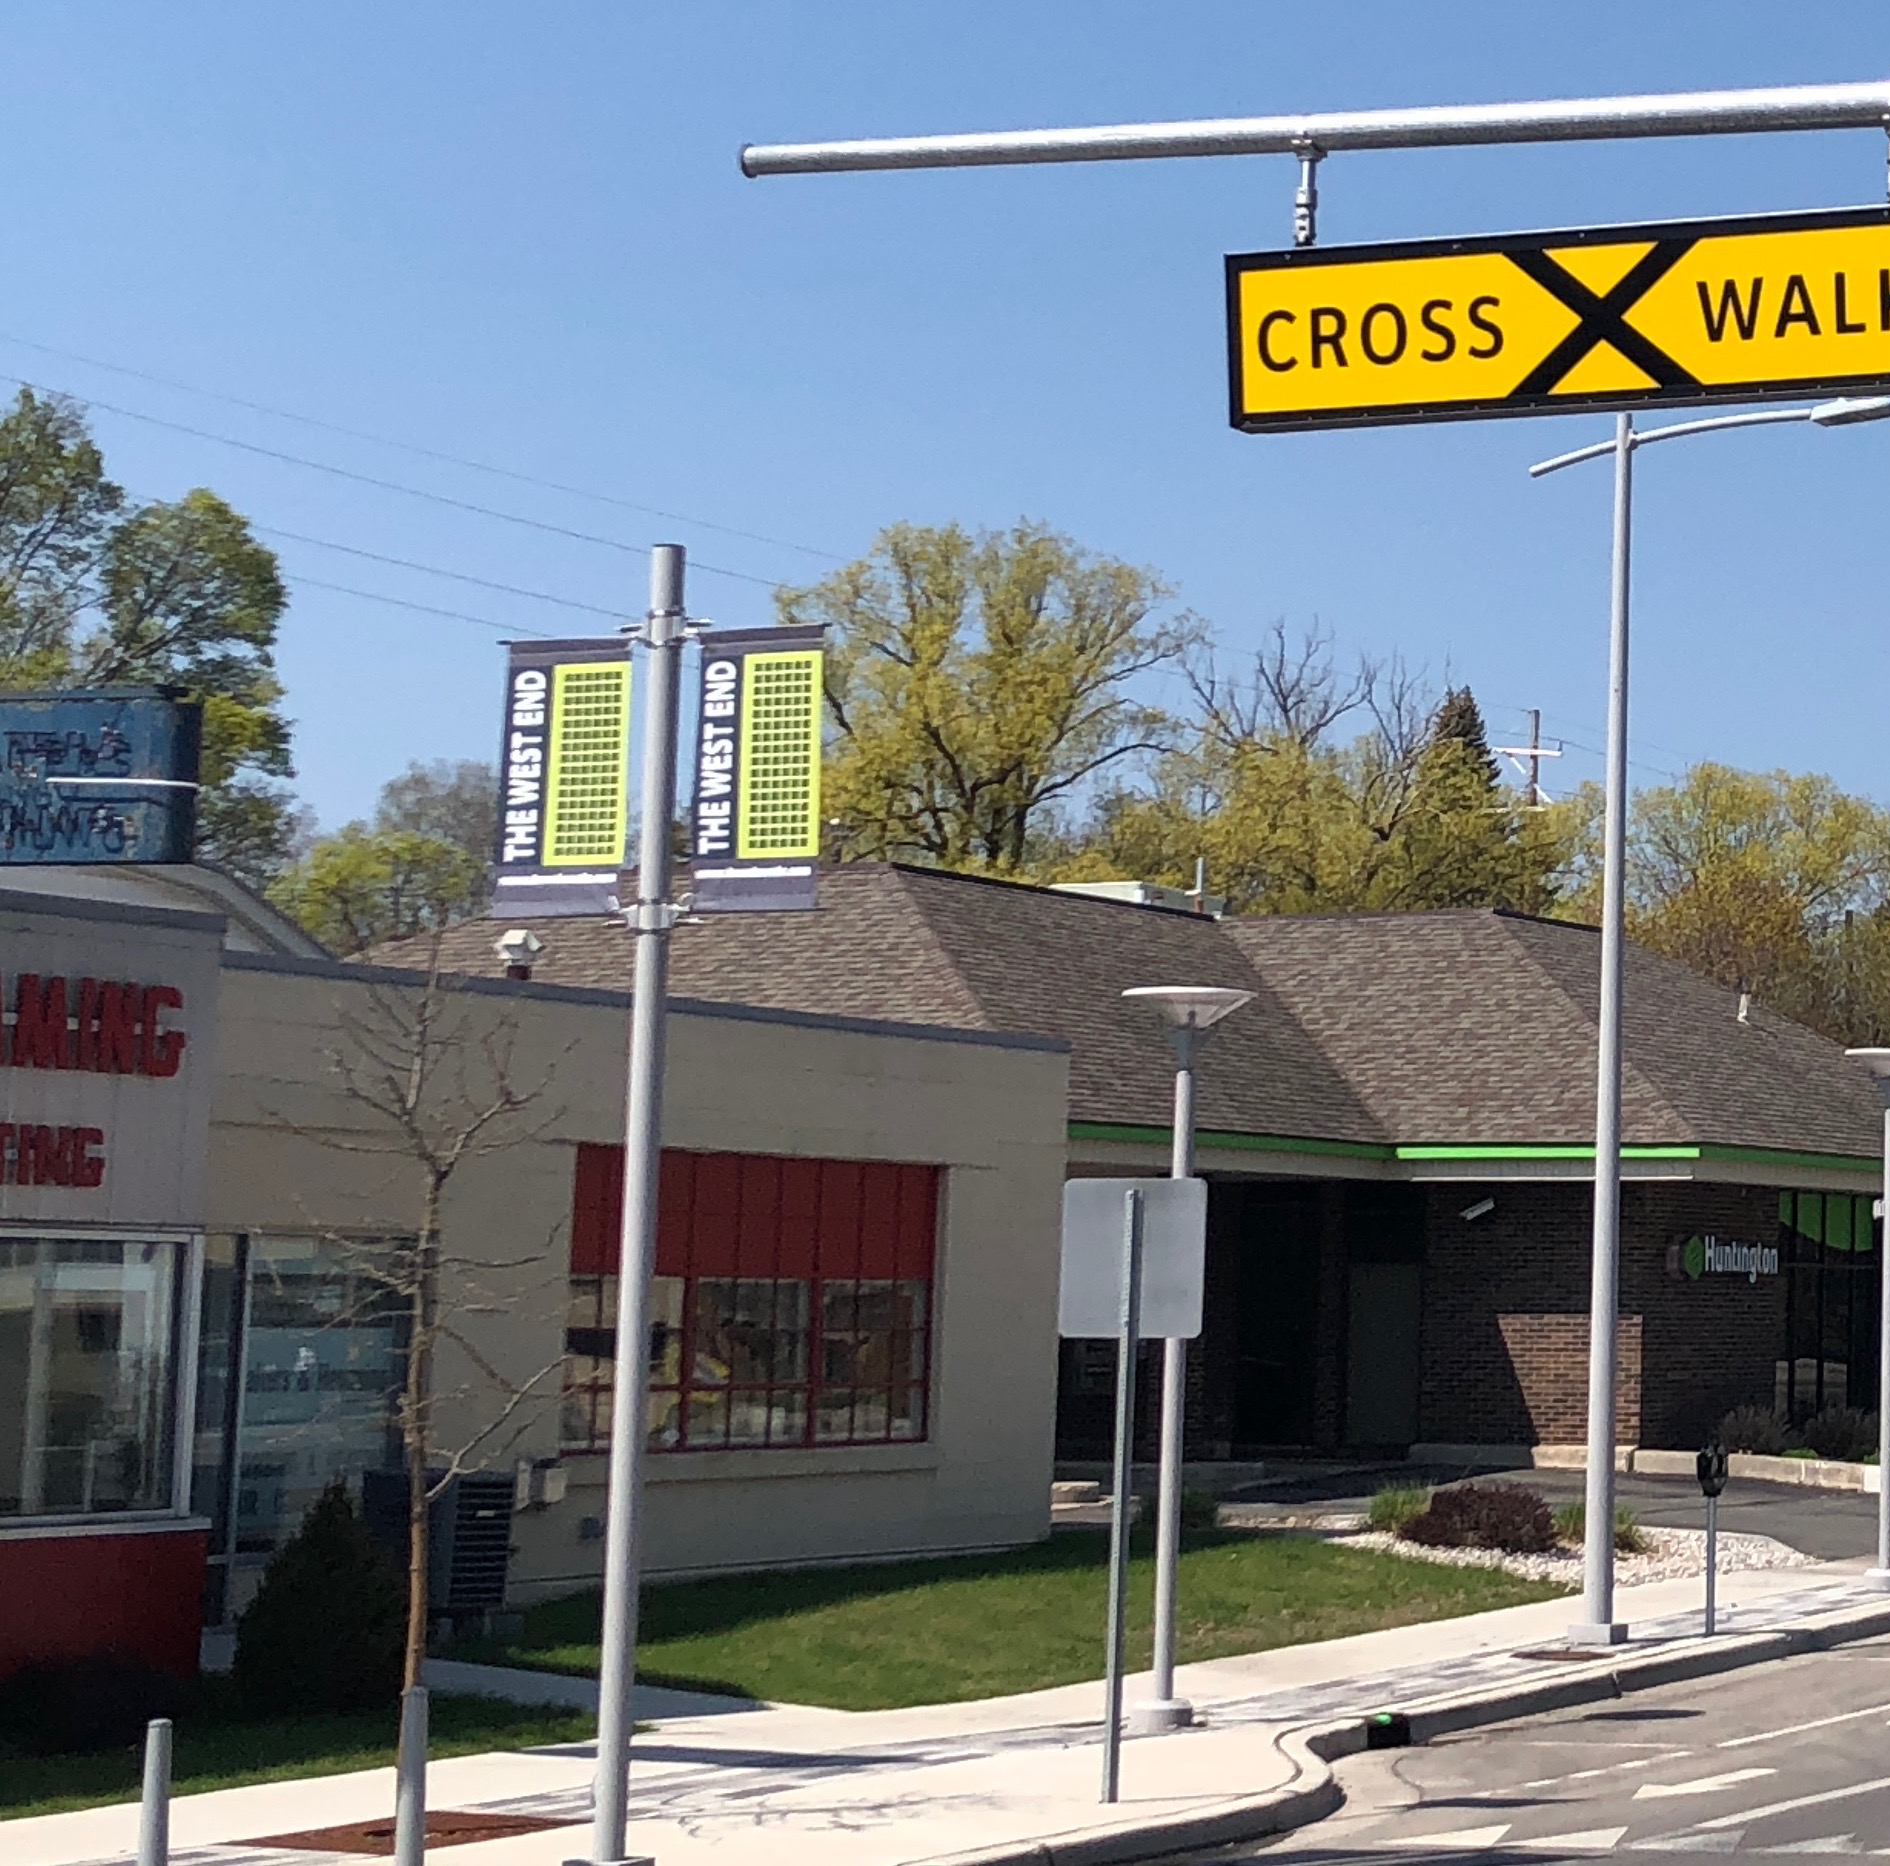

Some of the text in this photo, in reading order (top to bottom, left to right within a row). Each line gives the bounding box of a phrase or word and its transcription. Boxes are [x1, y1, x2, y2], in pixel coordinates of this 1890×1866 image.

[1257, 296, 1504, 372] CROSS
[503, 670, 547, 862] THE WEST END
[698, 660, 738, 854] THE WEST END
[0, 972, 185, 1077] MING
[1705, 1235, 1778, 1283] Huntington
